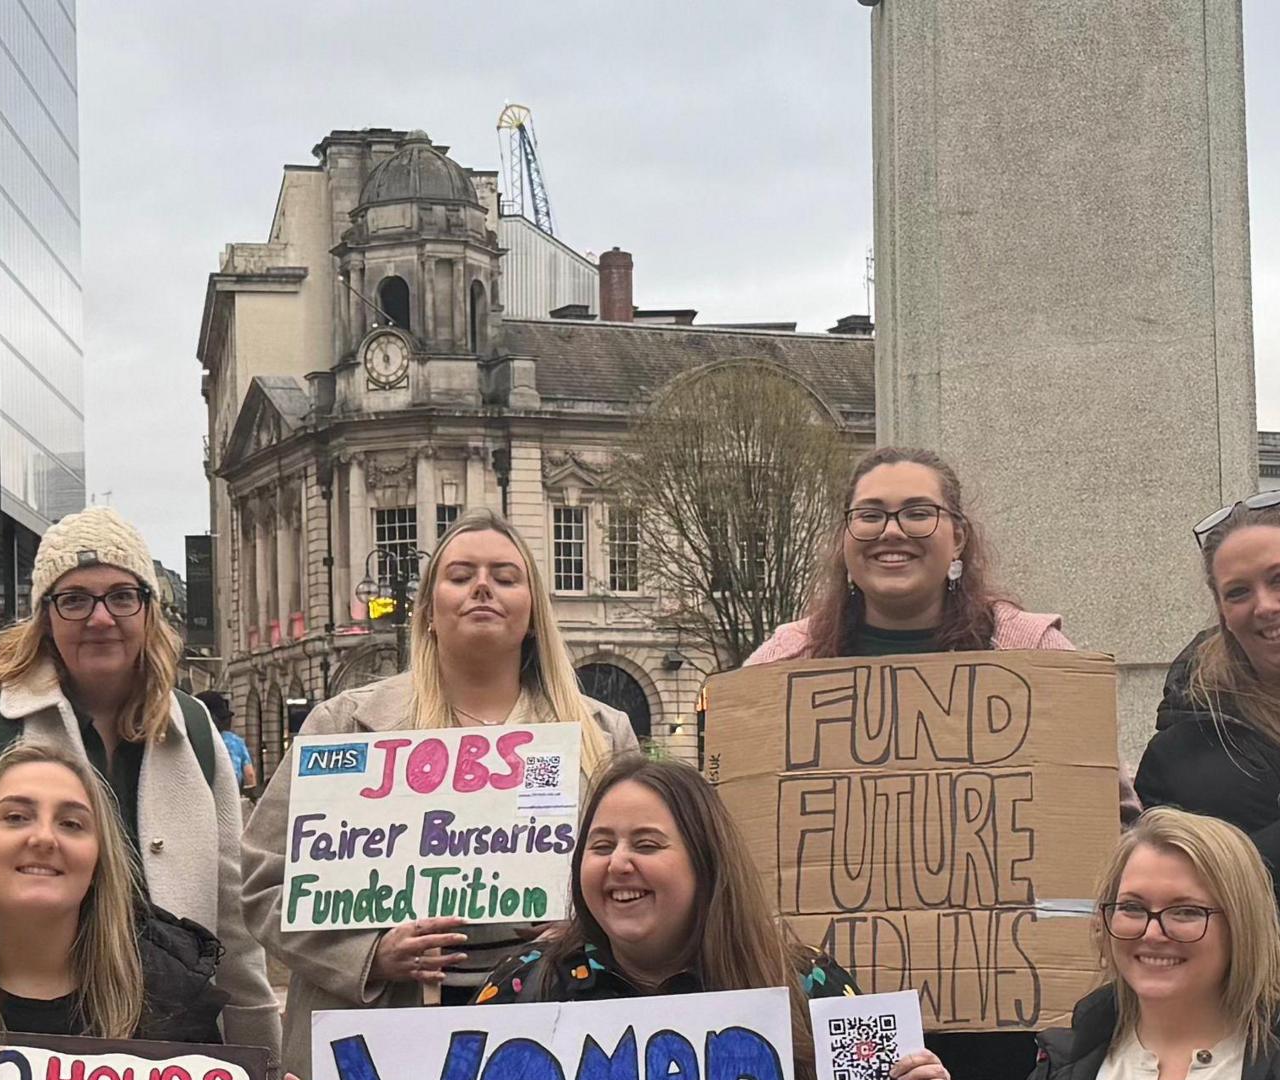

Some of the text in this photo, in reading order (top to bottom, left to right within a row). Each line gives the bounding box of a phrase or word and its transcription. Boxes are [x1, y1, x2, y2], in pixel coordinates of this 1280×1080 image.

[786, 664, 1031, 769] FUND
[307, 731, 534, 799] NHS JOBS
[291, 810, 577, 863] Fairer Bursaries
[777, 772, 1035, 913] FUTURE
[287, 865, 548, 925] Funded Tuition
